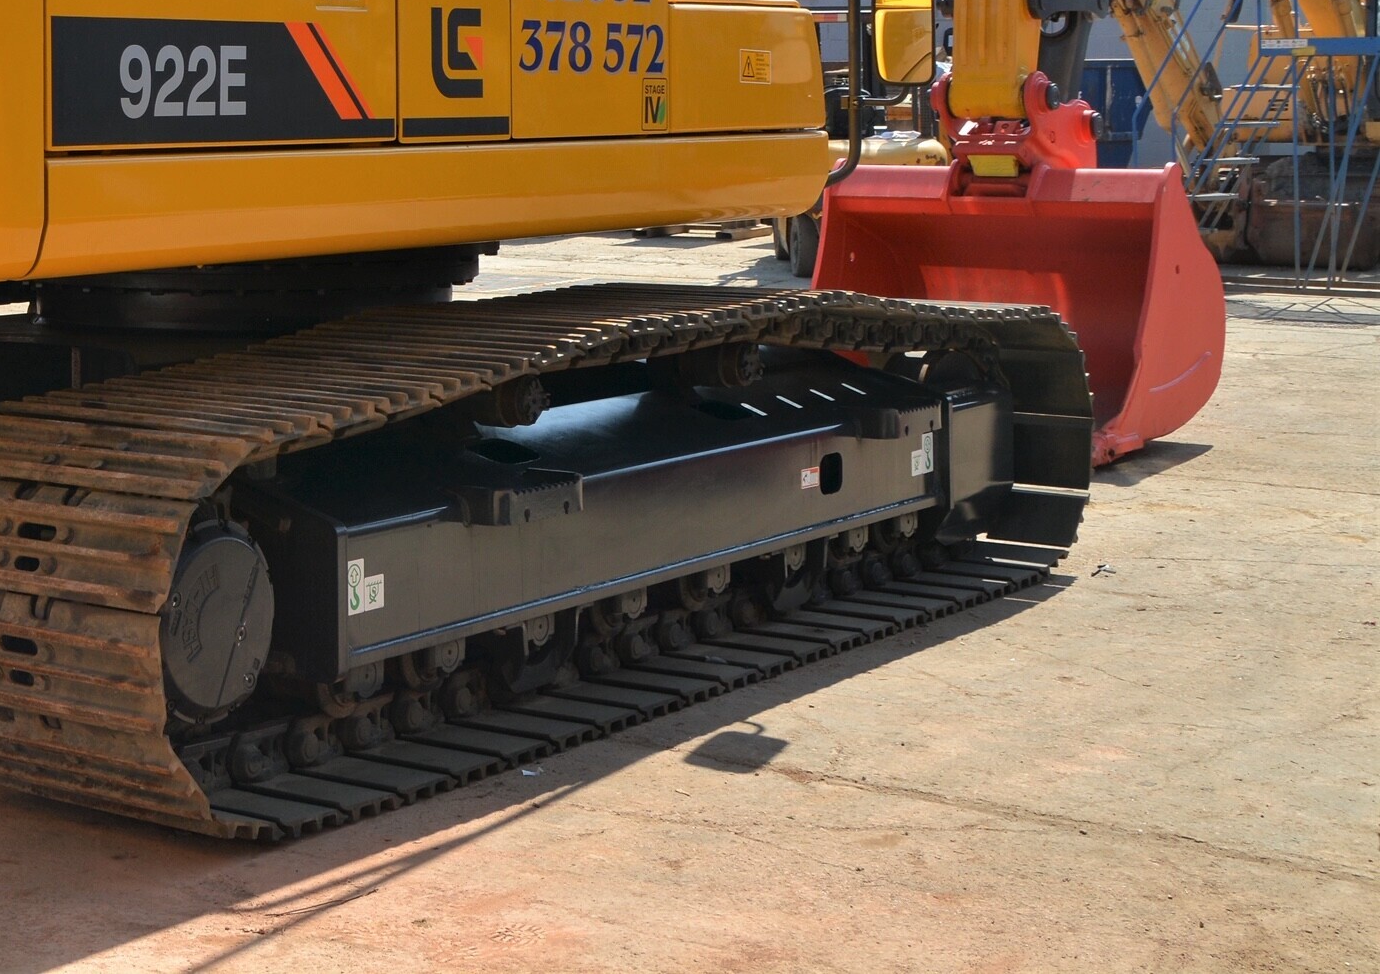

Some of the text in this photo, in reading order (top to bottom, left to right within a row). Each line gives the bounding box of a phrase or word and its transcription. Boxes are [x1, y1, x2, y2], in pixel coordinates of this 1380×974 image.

[519, 19, 665, 74] 378 572
[120, 44, 247, 119] 922E
[645, 85, 665, 94] STAGE
[645, 96, 661, 124] IV
